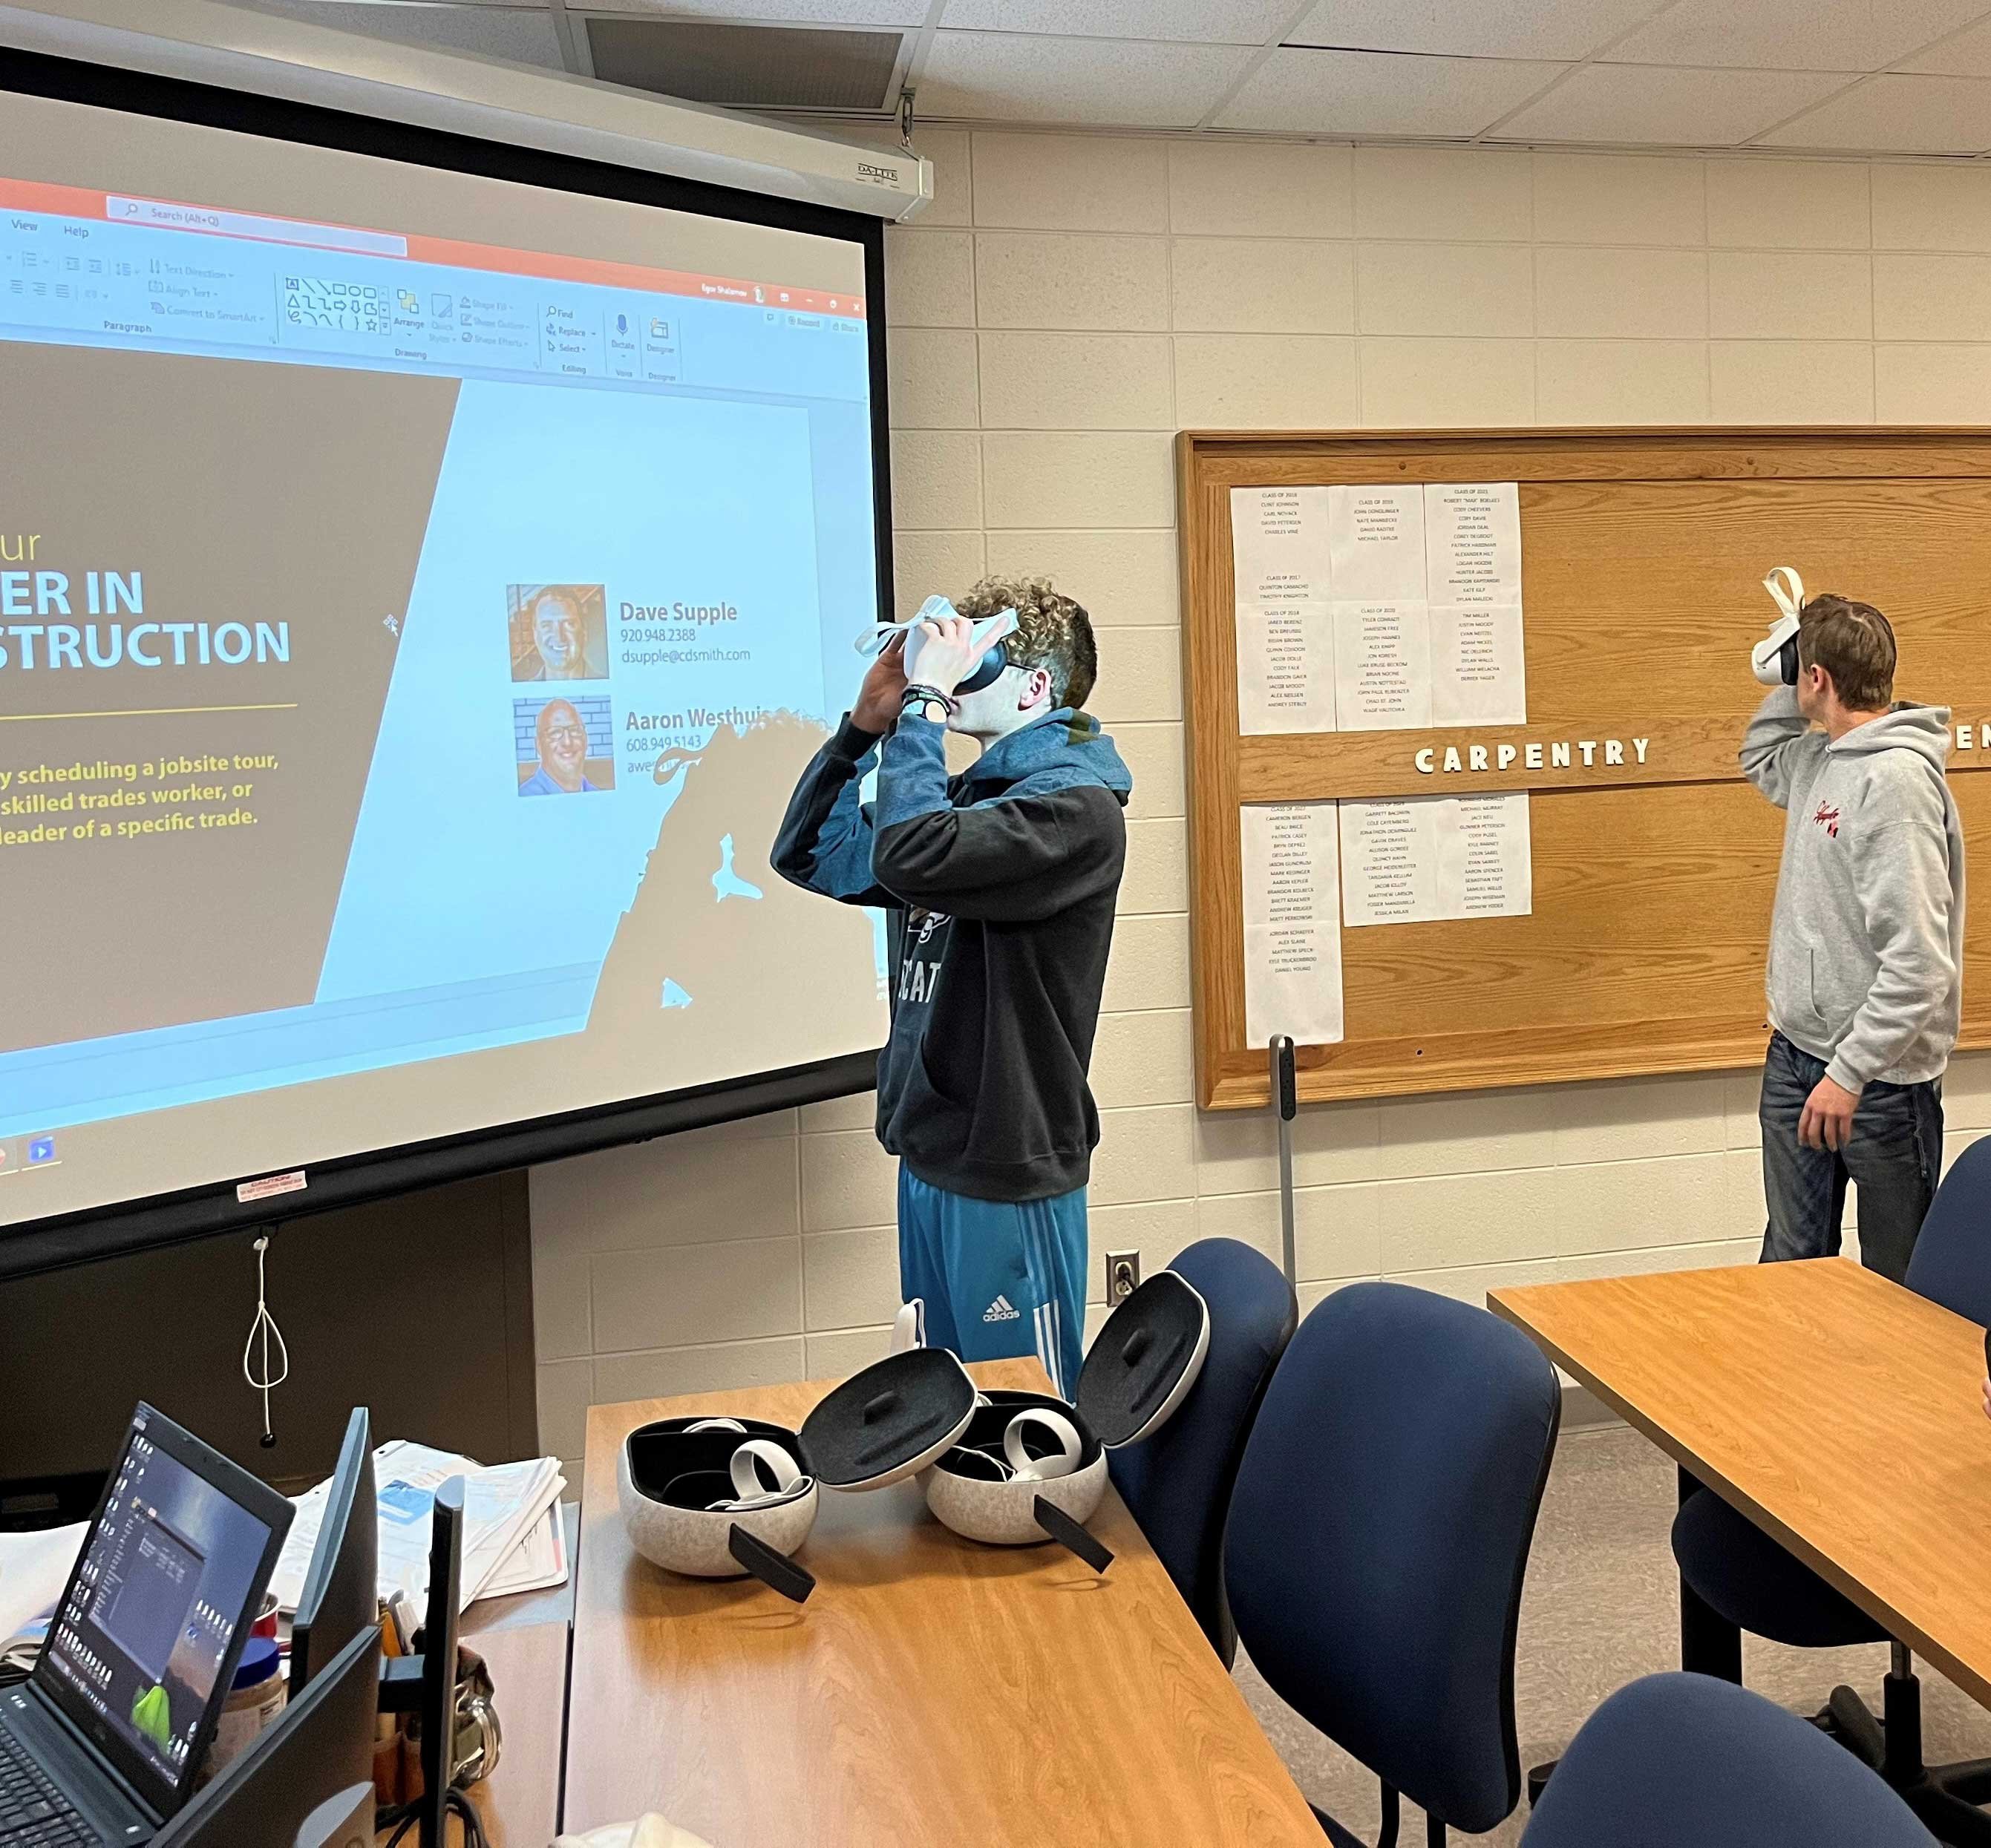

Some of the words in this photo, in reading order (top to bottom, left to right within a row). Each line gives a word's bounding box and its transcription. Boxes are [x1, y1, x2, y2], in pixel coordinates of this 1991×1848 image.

[857, 166, 897, 180] DA-LITE
[151, 208, 183, 223] Search
[183, 212, 220, 227] (Alt+Q)
[11, 219, 38, 232] View
[64, 225, 89, 239] Help
[165, 263, 183, 275] Text
[186, 266, 226, 279] Direction
[166, 285, 190, 297] Align
[192, 287, 210, 298] Text
[167, 305, 203, 318] Convert
[205, 310, 215, 319] to
[218, 310, 258, 323] SmartArt
[558, 309, 573, 318] Find
[104, 320, 152, 334] Paragraph
[394, 318, 425, 330] Arrange
[559, 326, 586, 338] Replace
[559, 344, 580, 353] Select
[611, 339, 635, 350] Dictate
[647, 343, 675, 355] Designer
[395, 348, 428, 360] Drawing
[562, 364, 586, 375] Editing
[648, 372, 676, 382] Designer
[0, 534, 41, 561] ur
[1, 570, 72, 615] ER
[86, 571, 143, 615] IN
[620, 602, 668, 622] Dave
[673, 602, 737, 626] Supple
[621, 629, 696, 642] 920.948.2388
[622, 649, 751, 665] dsupple@cdsmith.com
[626, 711, 684, 731] Aaron
[687, 705, 768, 727] Westhui
[626, 735, 701, 752] 608.949.5143
[1415, 738, 1649, 773] CARPENTRY
[17, 761, 137, 784] scheduling
[142, 763, 154, 776] a
[158, 754, 229, 780] jobsite
[232, 753, 278, 770] tour,
[1, 792, 73, 816] skilled
[79, 788, 146, 810] trades
[151, 783, 227, 805] worker,
[232, 783, 253, 798] or
[72, 819, 95, 839] of
[99, 823, 112, 836] a
[117, 813, 194, 839] specific
[199, 807, 258, 828] trade.
[983, 1310, 1020, 1322] adidas
